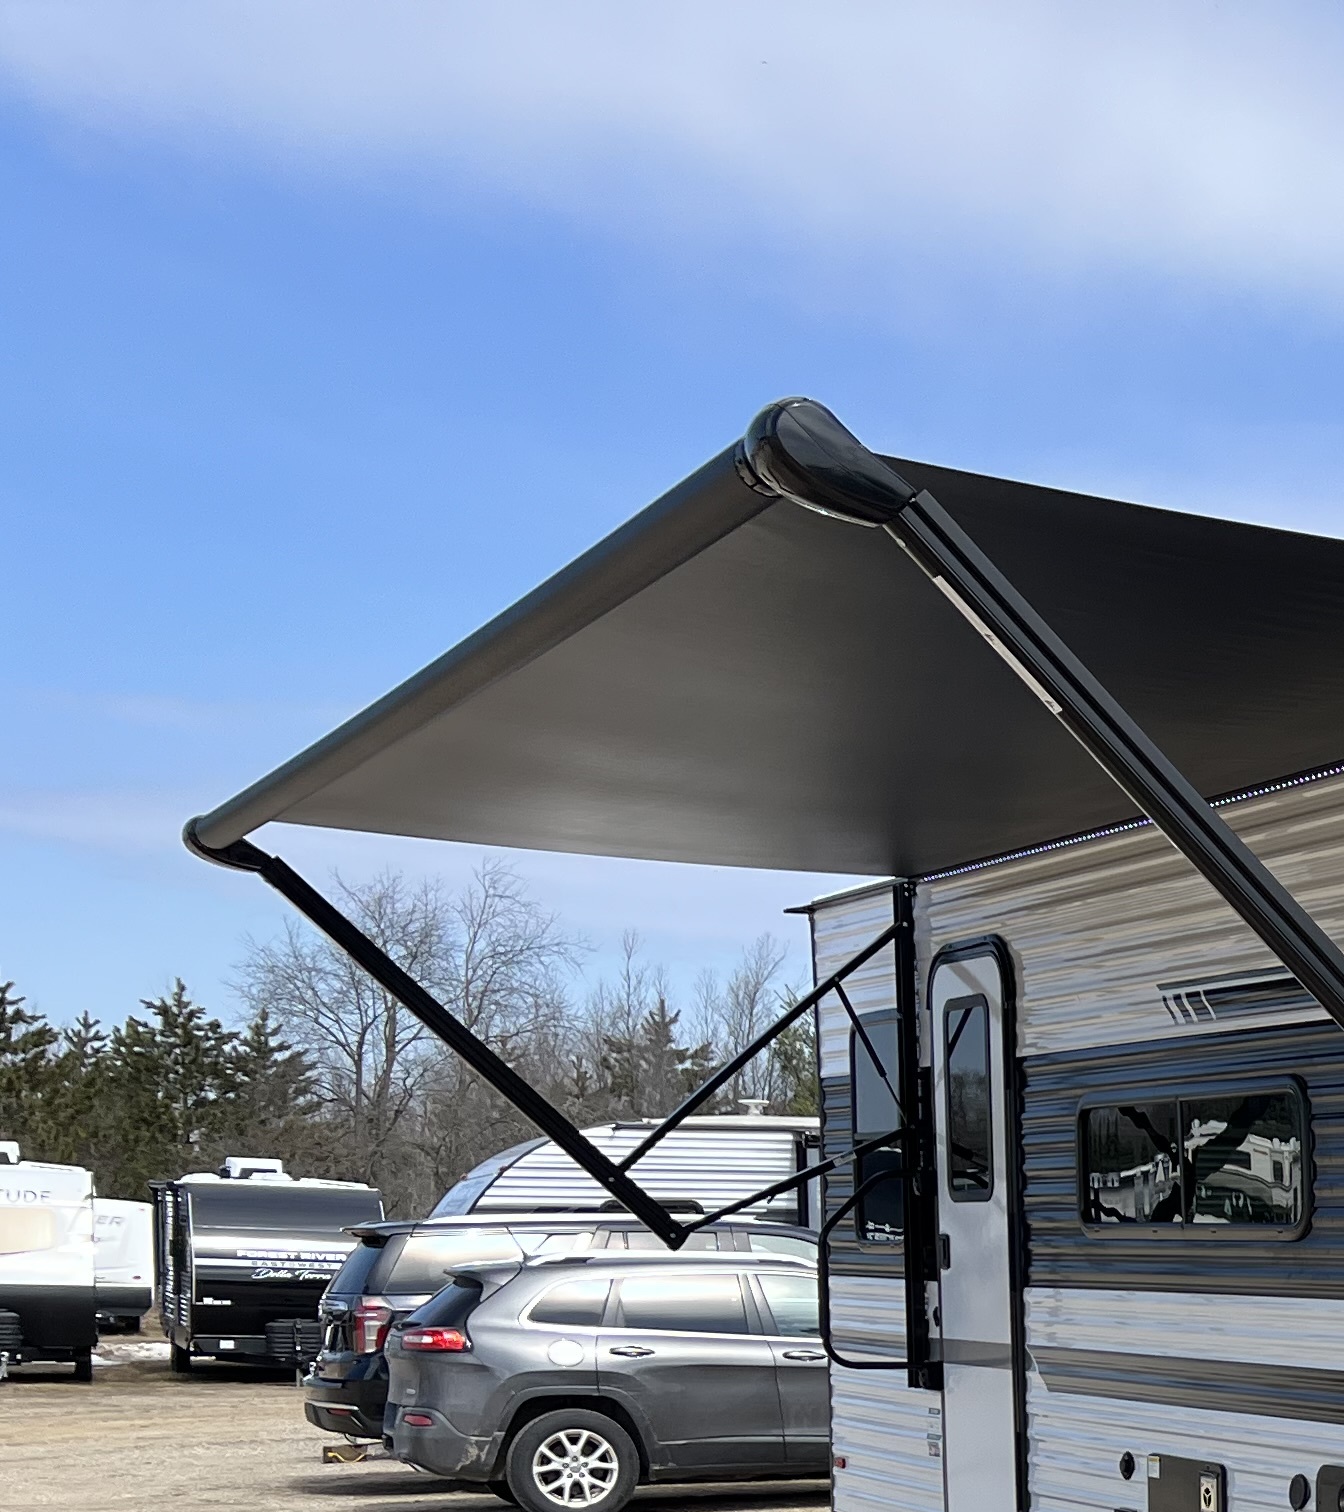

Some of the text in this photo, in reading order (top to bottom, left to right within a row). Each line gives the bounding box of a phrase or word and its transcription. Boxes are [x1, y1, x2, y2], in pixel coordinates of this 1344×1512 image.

[0, 1189, 51, 1203] UDE
[236, 1249, 347, 1261] FOREST RIVER
